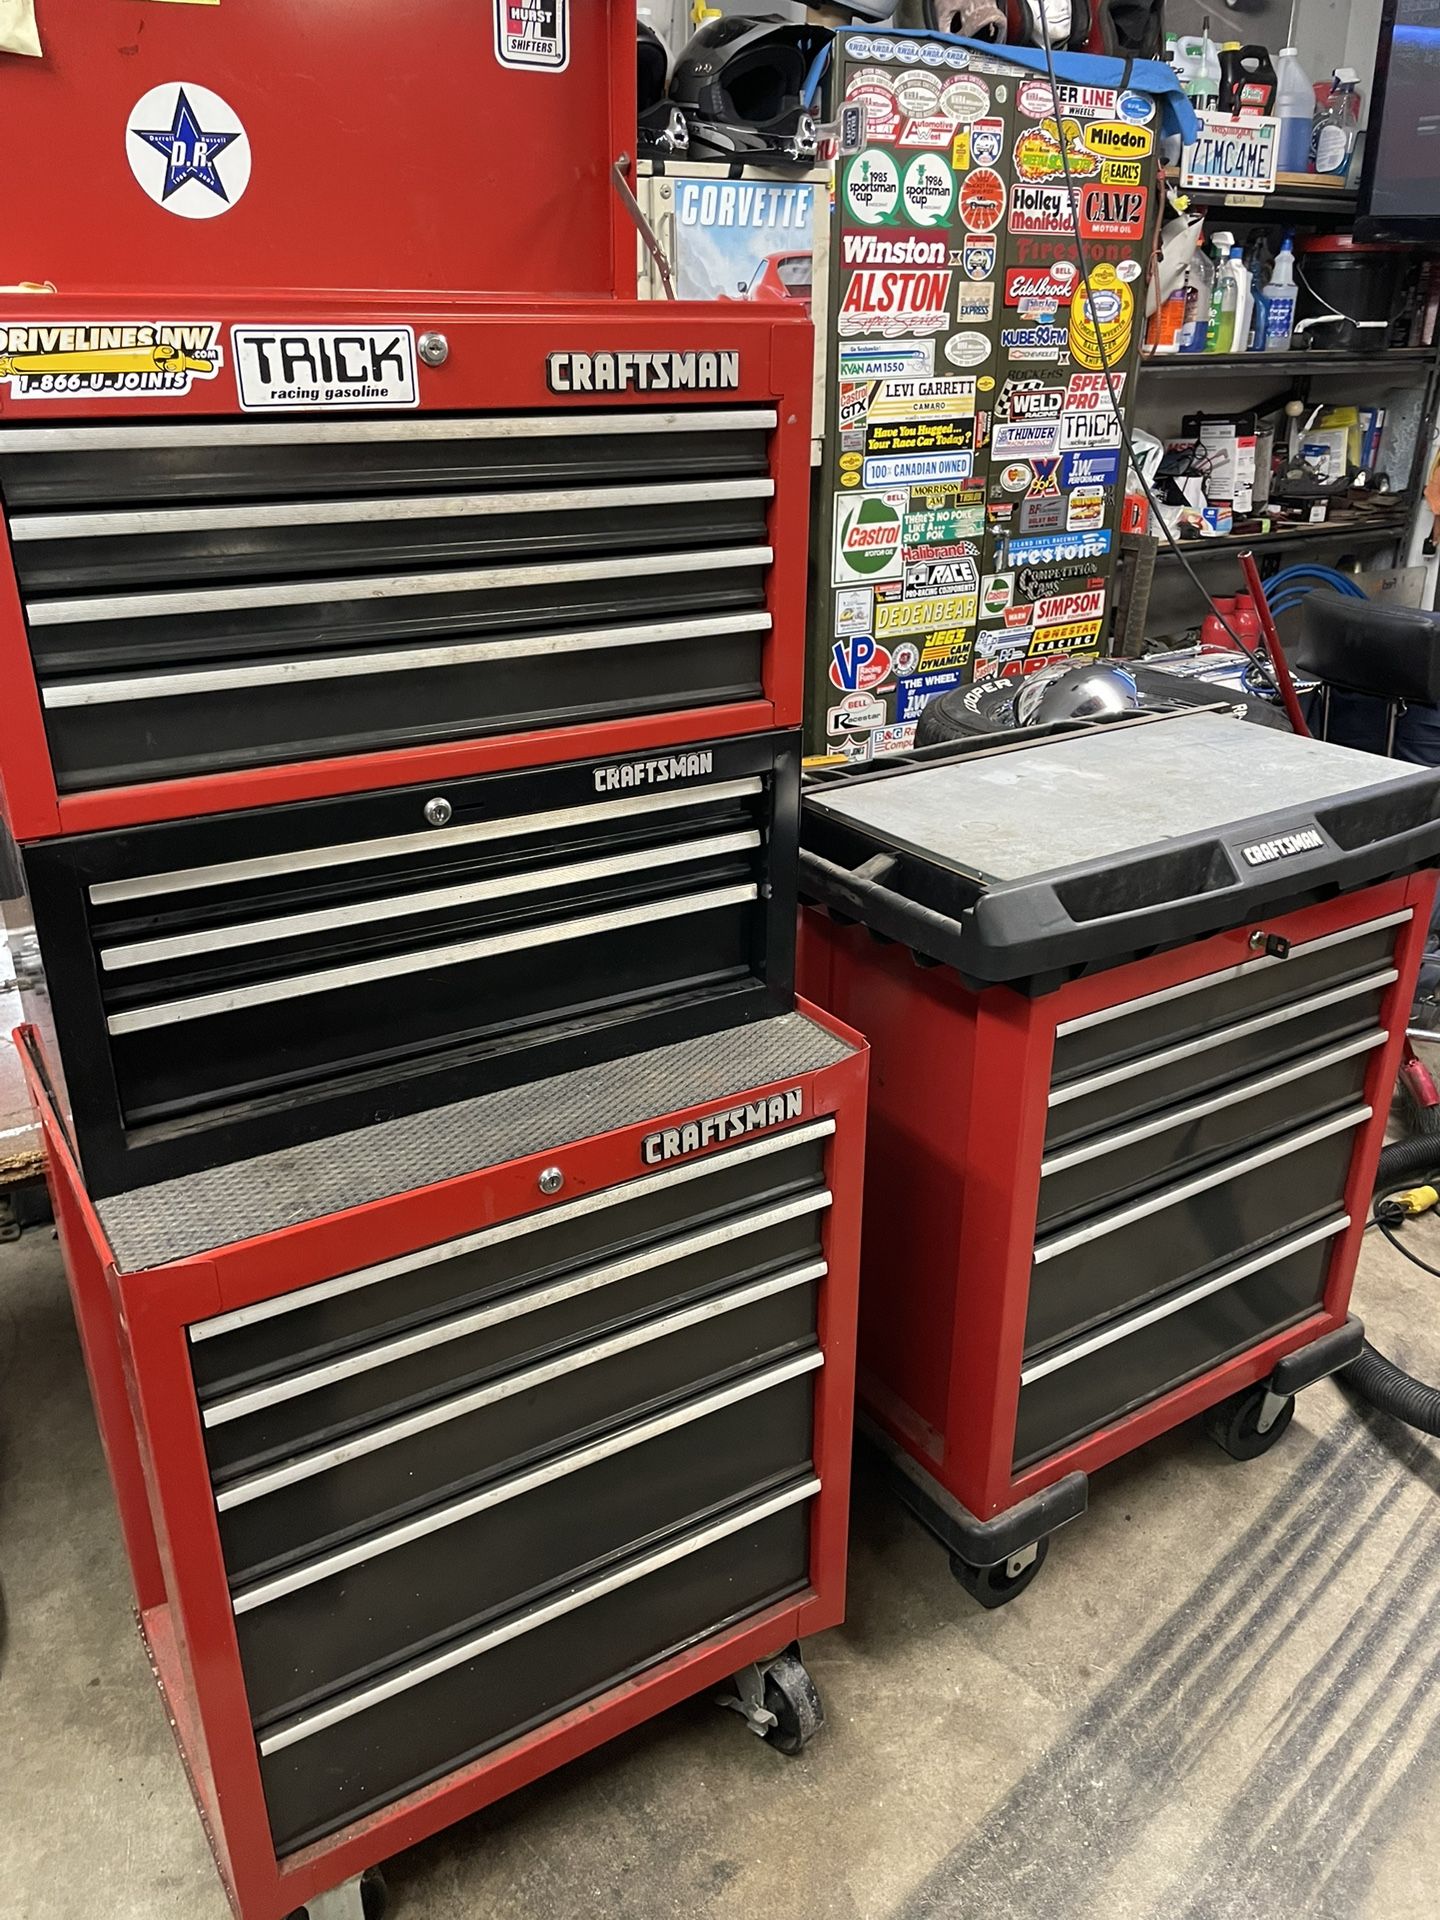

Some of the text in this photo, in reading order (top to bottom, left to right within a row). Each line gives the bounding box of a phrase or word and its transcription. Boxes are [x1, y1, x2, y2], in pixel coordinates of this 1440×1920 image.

[511, 7, 552, 23] HURST
[511, 39, 552, 53] SHIFTERS
[1082, 89, 1114, 107] LINE
[1069, 108, 1095, 117] WHEELS
[906, 120, 953, 139] Automotive
[1090, 127, 1146, 149] Milodon
[171, 141, 212, 167] D.R.
[870, 172, 888, 188] 1985
[1110, 163, 1139, 180] EARL'S
[850, 182, 896, 197] sportsman
[925, 176, 943, 191] 1986
[855, 193, 873, 206] cup
[906, 187, 950, 204] sportsman
[911, 197, 928, 209] cup
[1013, 189, 1061, 217] Holley
[681, 185, 810, 228] CORVETTE
[1086, 192, 1142, 223] CAM2
[1092, 224, 1119, 233] MOTOR
[843, 235, 945, 264] Winston
[1055, 267, 1072, 275] BELL
[843, 273, 949, 312] ALSTON
[1010, 276, 1072, 297] Edelbrock
[192, 350, 217, 360] .COM
[243, 337, 404, 384] TRICK
[547, 351, 739, 393] CRAFTSMAN
[841, 362, 905, 375] KVAN AM 1550
[20, 373, 187, 392] 1-866-U-JOINTS
[886, 380, 974, 397] LEVI GARRETT
[271, 385, 389, 400] racing gasoline
[841, 386, 868, 407] Castrol
[841, 399, 867, 420] GTX
[913, 402, 946, 411] CAMARO
[1013, 394, 1062, 414] WELD
[1066, 393, 1099, 410] PRO
[874, 423, 961, 438] Have You Hugged...
[1008, 427, 1056, 440] THUNDER
[1065, 415, 1118, 438] TRICK
[868, 439, 891, 450] Your
[892, 438, 915, 448] Race
[916, 436, 934, 447] Car
[894, 462, 937, 477] CANADIAN
[939, 460, 967, 474] OWNED
[886, 493, 905, 502] BELL
[914, 483, 959, 495] MORRISON
[930, 497, 943, 506] AM
[937, 510, 949, 521] NO
[951, 510, 973, 519] POKE
[848, 524, 900, 548] Castrol
[903, 530, 944, 542] SLO POK
[908, 523, 925, 532] LIKE
[1052, 535, 1079, 544] RACEWAY
[901, 542, 966, 562] Halibrand
[1007, 543, 1103, 568] irestone
[929, 561, 974, 585] RACE
[905, 583, 975, 598] PRO-RACING COMPONENTS
[878, 599, 976, 629] DEDENBEAR
[1037, 593, 1100, 619] SIMPSON
[1008, 611, 1027, 621] WARN
[1036, 622, 1098, 640] LONESTAR
[950, 644, 970, 655] CAM
[1037, 635, 1092, 652] RACING
[833, 634, 876, 692] VP
[921, 654, 968, 671] DYNAMICS
[848, 700, 867, 709] BELL
[834, 712, 881, 729] Racestar
[875, 727, 916, 743] B&G Ra
[884, 739, 914, 750] Compu
[593, 751, 713, 792] CRAFTSMAN
[1242, 829, 1325, 866] CRAFTSMAN
[644, 1088, 803, 1165] CRAFTSMAN
